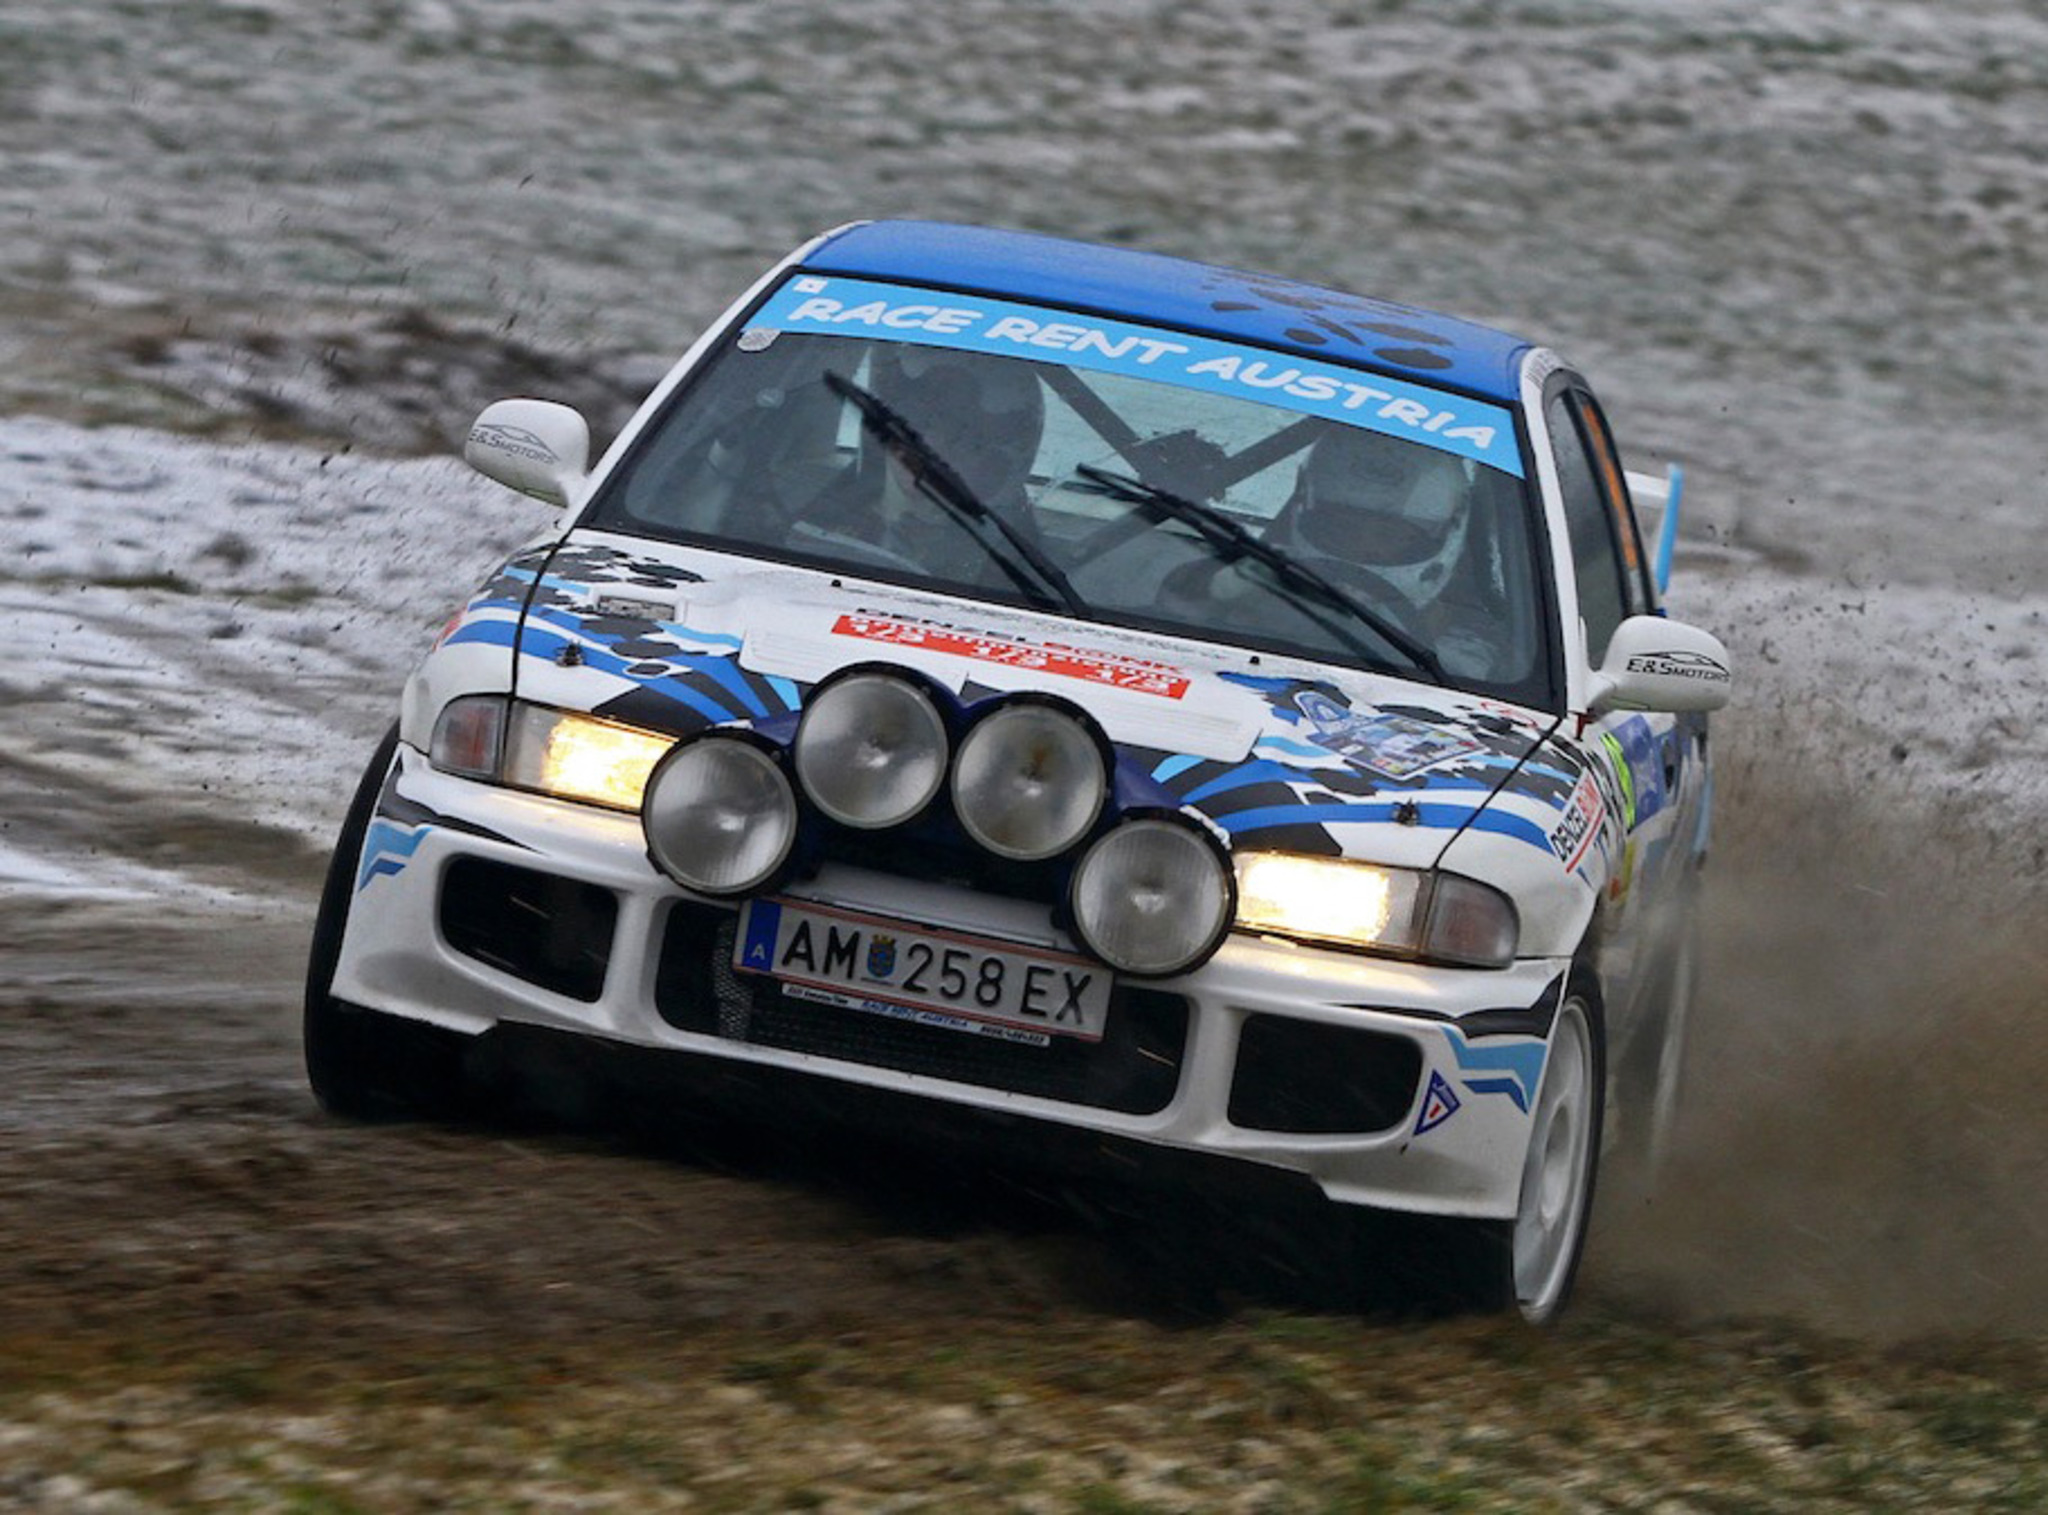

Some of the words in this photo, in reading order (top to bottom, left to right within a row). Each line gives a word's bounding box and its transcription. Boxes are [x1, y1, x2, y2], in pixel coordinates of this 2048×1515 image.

[787, 298, 984, 333] RACE
[984, 316, 1190, 365] RENT
[1186, 356, 1497, 449] AUSTRIA
[751, 943, 766, 961] A
[781, 919, 861, 980] AM
[901, 942, 1005, 1007] 258
[1019, 964, 1094, 1025] EX
